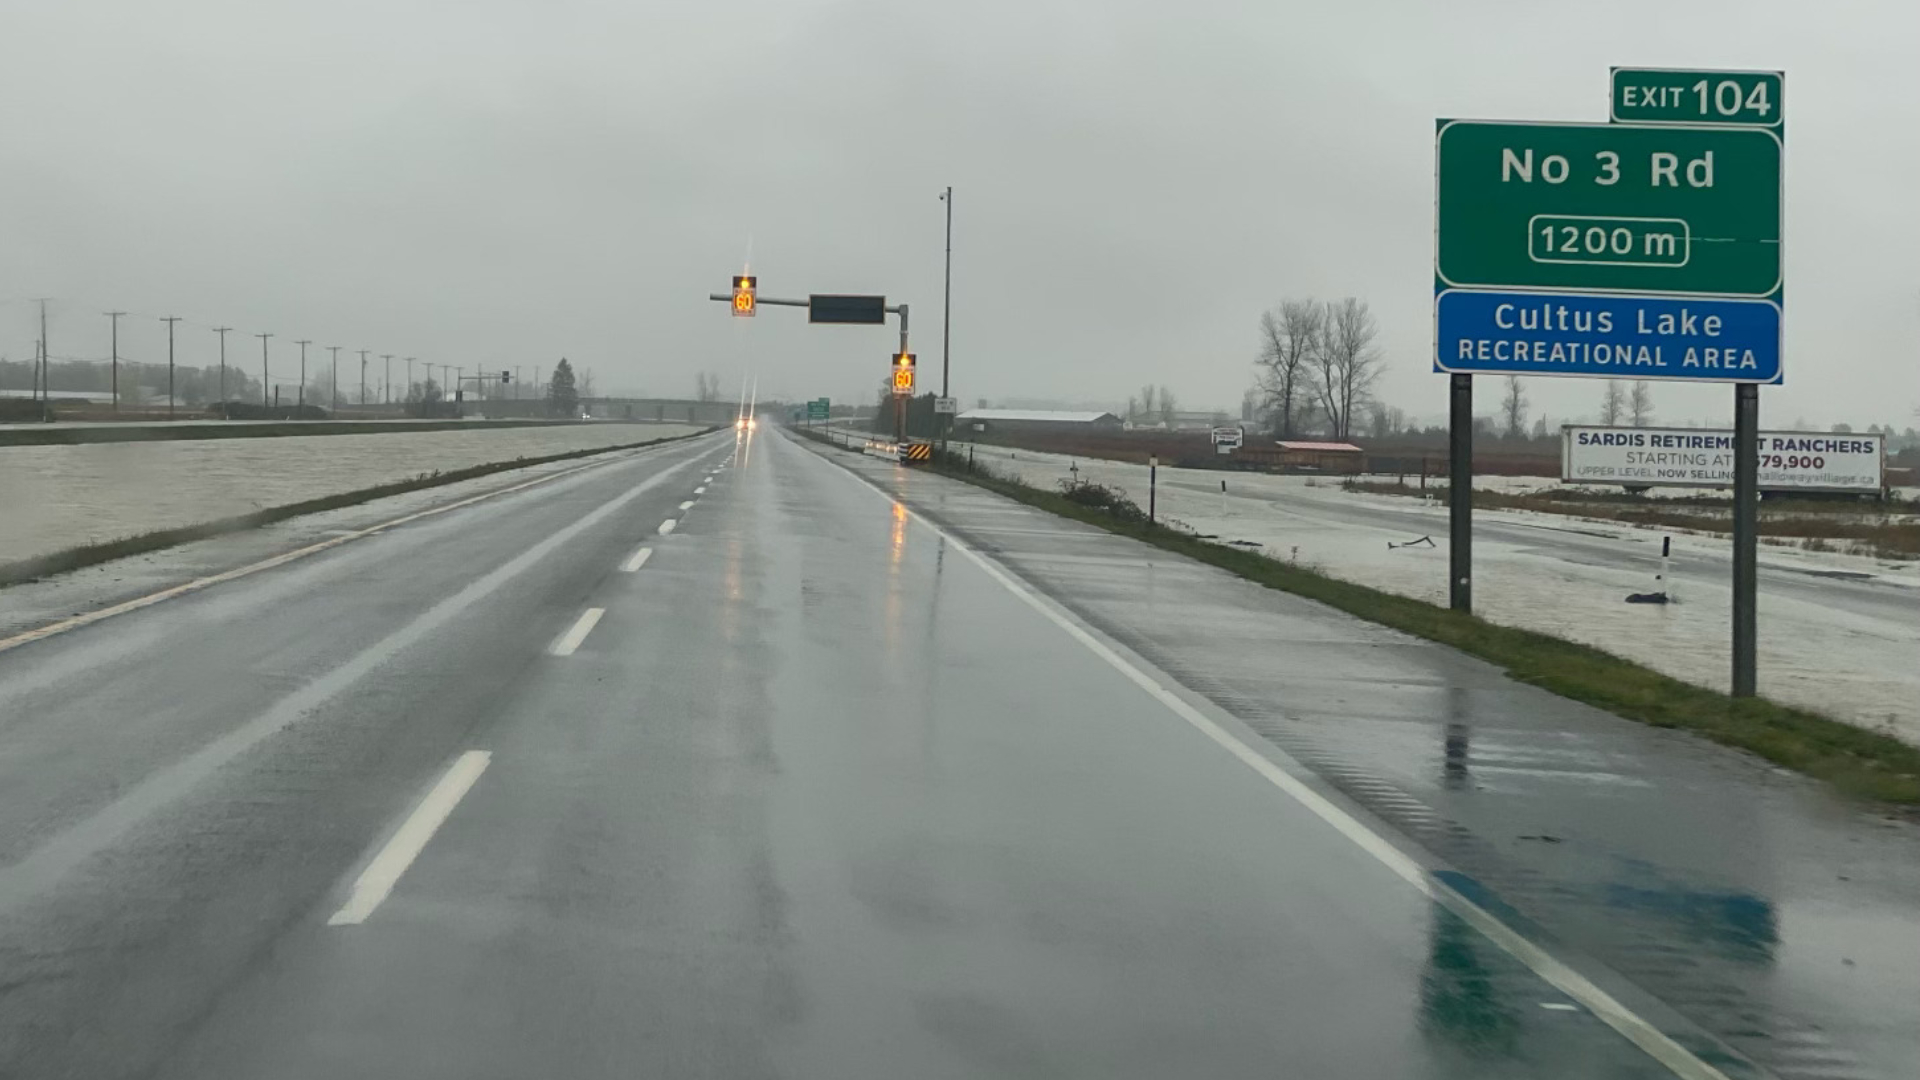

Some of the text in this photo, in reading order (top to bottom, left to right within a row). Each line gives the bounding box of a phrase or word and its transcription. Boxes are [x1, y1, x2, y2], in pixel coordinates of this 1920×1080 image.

[1622, 80, 1771, 117] EXIT 104
[1502, 148, 1714, 188] No 3 Rd
[1541, 226, 1676, 256] 1200 m
[736, 293, 752, 310] 60
[1495, 303, 1723, 337] Cultus Lake
[1458, 340, 1758, 370] RECREATIONAL AREA
[895, 371, 912, 388] 60
[1578, 432, 1874, 454] SARDIS RETIREMT RANCHERS
[1577, 466, 1615, 477] UPPER
[1618, 467, 1653, 478] LEVEL
[1657, 469, 1687, 479] NOW
[1626, 451, 1825, 470] STARTING AT 79,900
